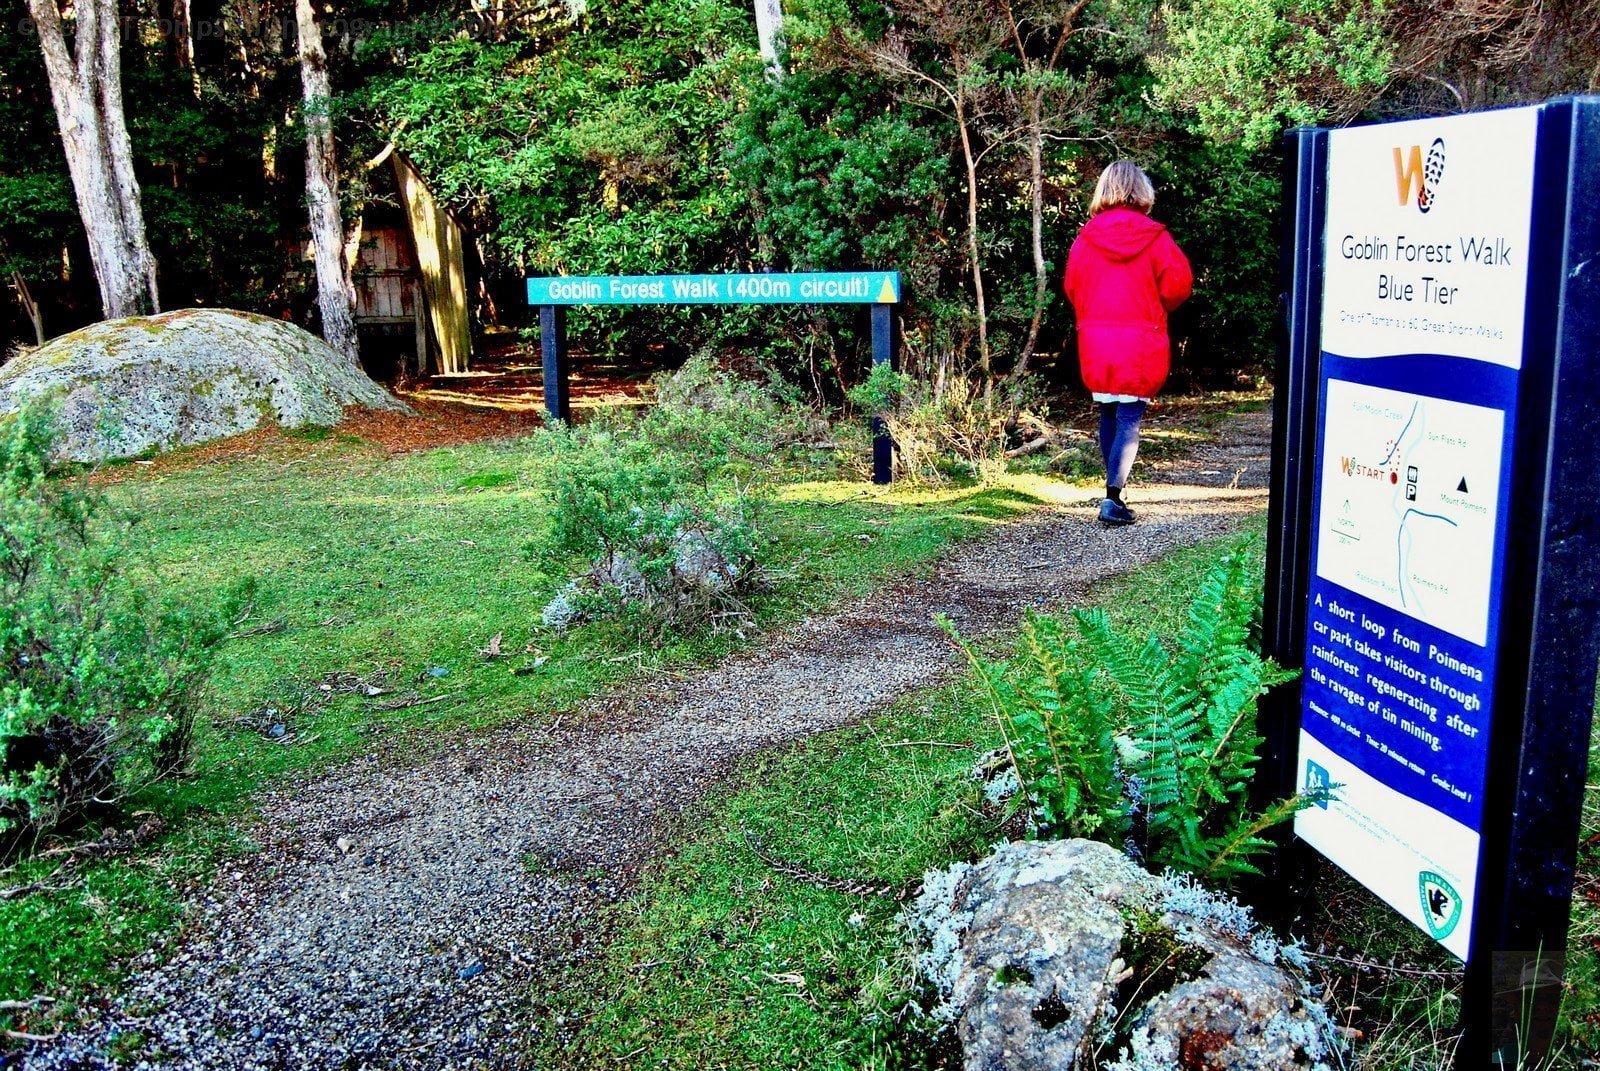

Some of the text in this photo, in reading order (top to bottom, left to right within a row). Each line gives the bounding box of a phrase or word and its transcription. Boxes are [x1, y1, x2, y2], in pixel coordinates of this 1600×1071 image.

[1342, 235, 1511, 266] Goblin Forest Walk
[549, 276, 869, 299] Goblin Forest Walk (400m circuit)
[1378, 275, 1458, 305] Blue Tier
[1421, 318, 1445, 333] Great
[1476, 326, 1503, 340] Walks
[1356, 465, 1385, 481] START
[1315, 593, 1483, 682] A short loop from Poimena
[1313, 620, 1481, 711] car park takes visitors through
[1312, 645, 1479, 738] rainforest regenerating after
[1310, 668, 1442, 752] the ravages of tin mining.
